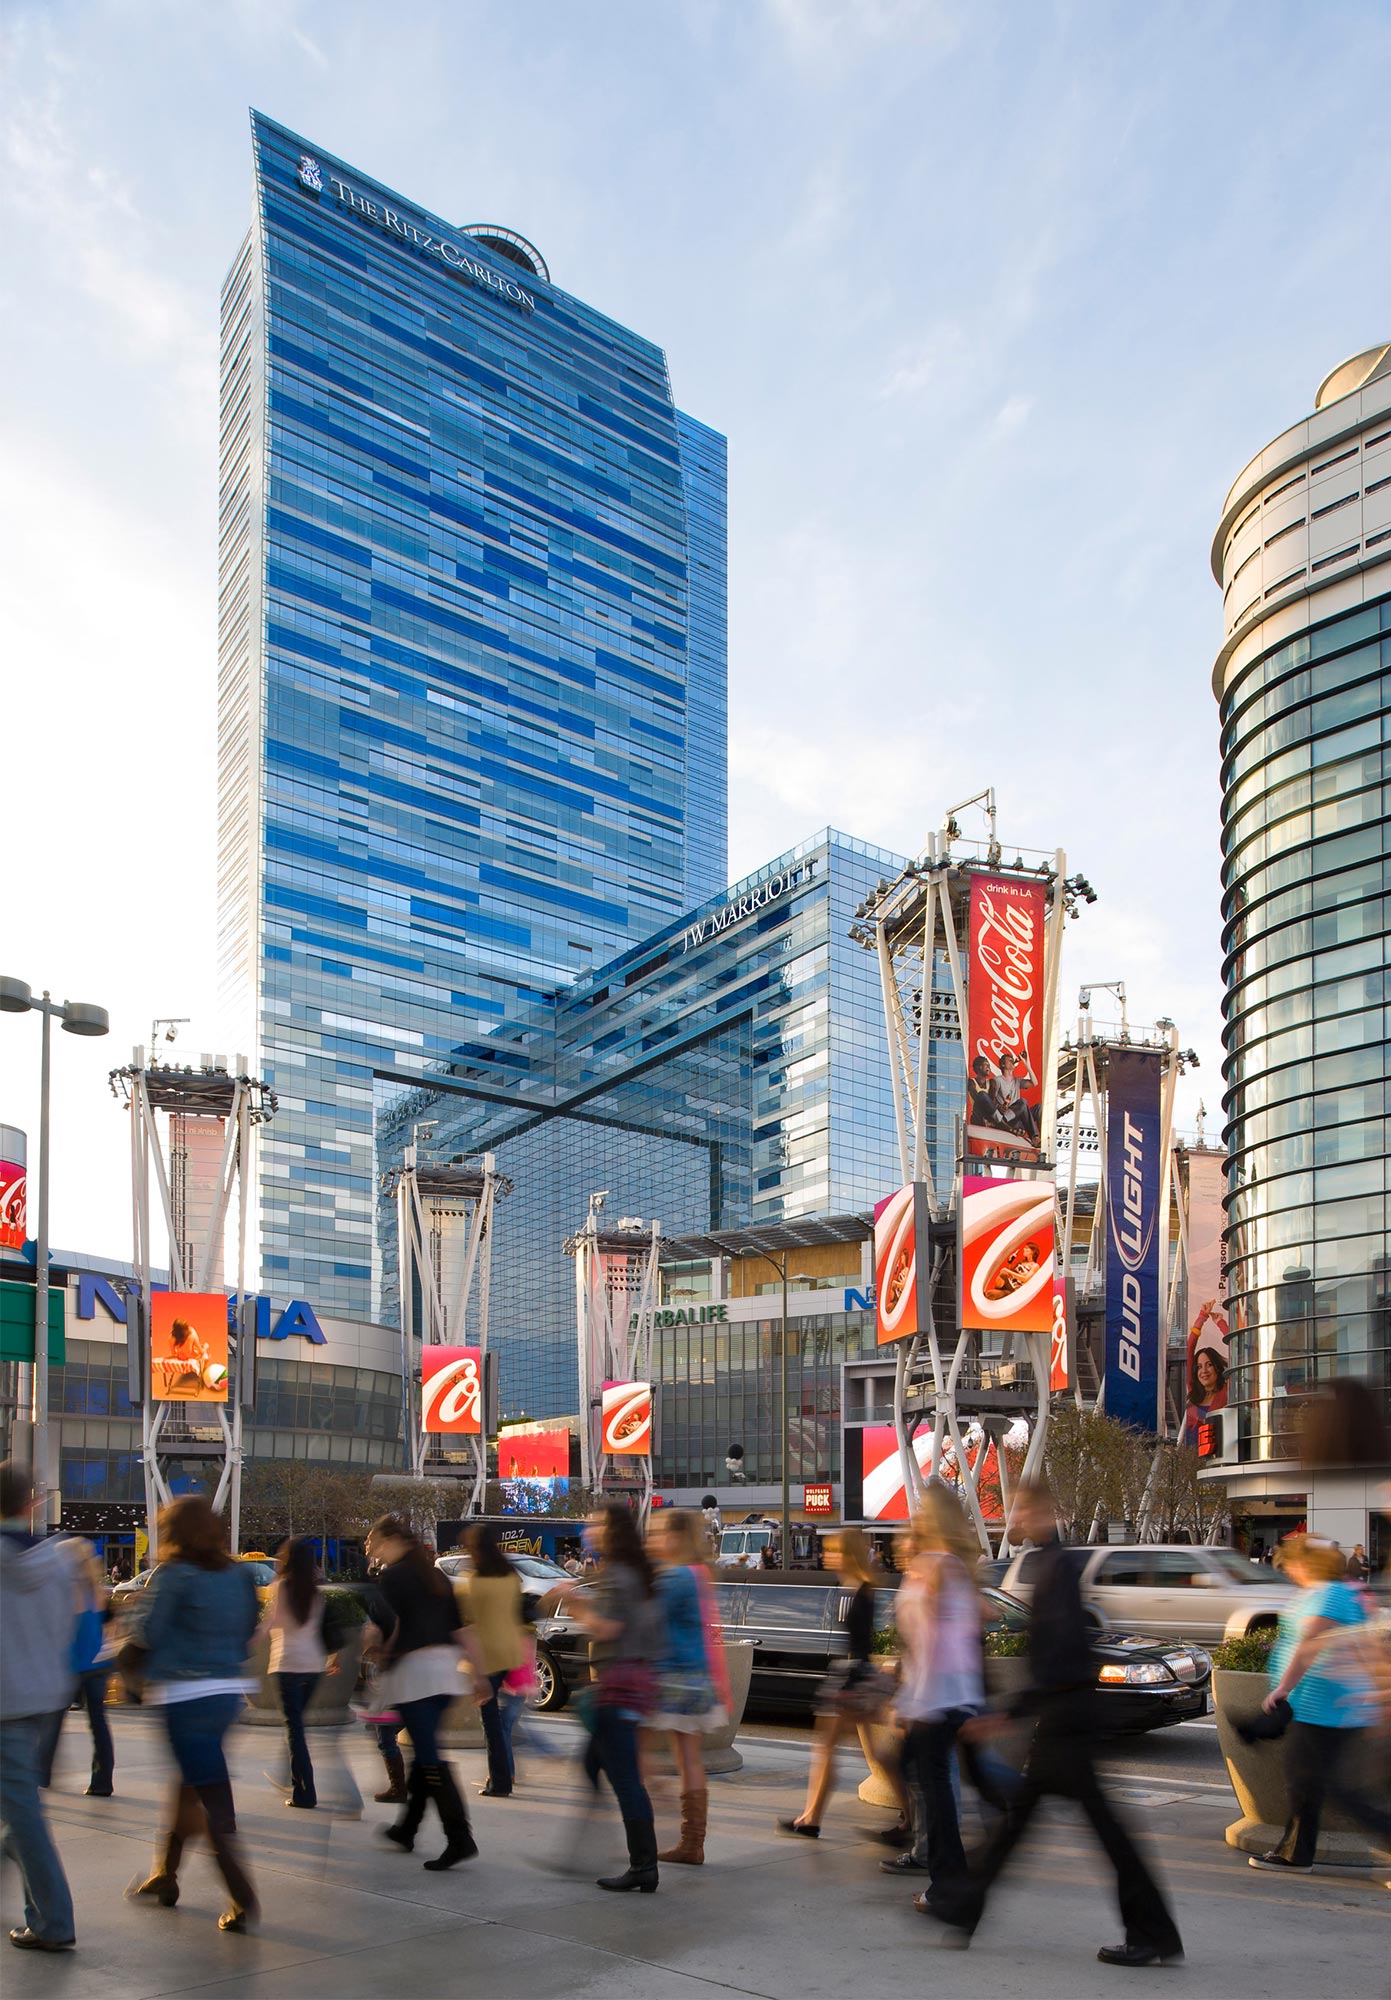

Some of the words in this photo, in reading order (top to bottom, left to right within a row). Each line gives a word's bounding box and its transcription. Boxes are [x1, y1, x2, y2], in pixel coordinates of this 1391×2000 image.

[331, 176, 379, 220] THE
[384, 207, 536, 313] RITZ-CARLTON
[682, 919, 707, 955] JW
[710, 856, 815, 937] MARRIOTT
[986, 883, 1009, 895] drink
[1010, 886, 1019, 896] in
[1020, 888, 1033, 898] LA
[976, 888, 1034, 1078] Coca-Cola
[1119, 1110, 1144, 1256] LIGHT
[79, 1273, 328, 1344] NIA
[1118, 1271, 1143, 1383] BUD
[501, 1529, 525, 1541] 102.7
[805, 1494, 830, 1507] PUCK
